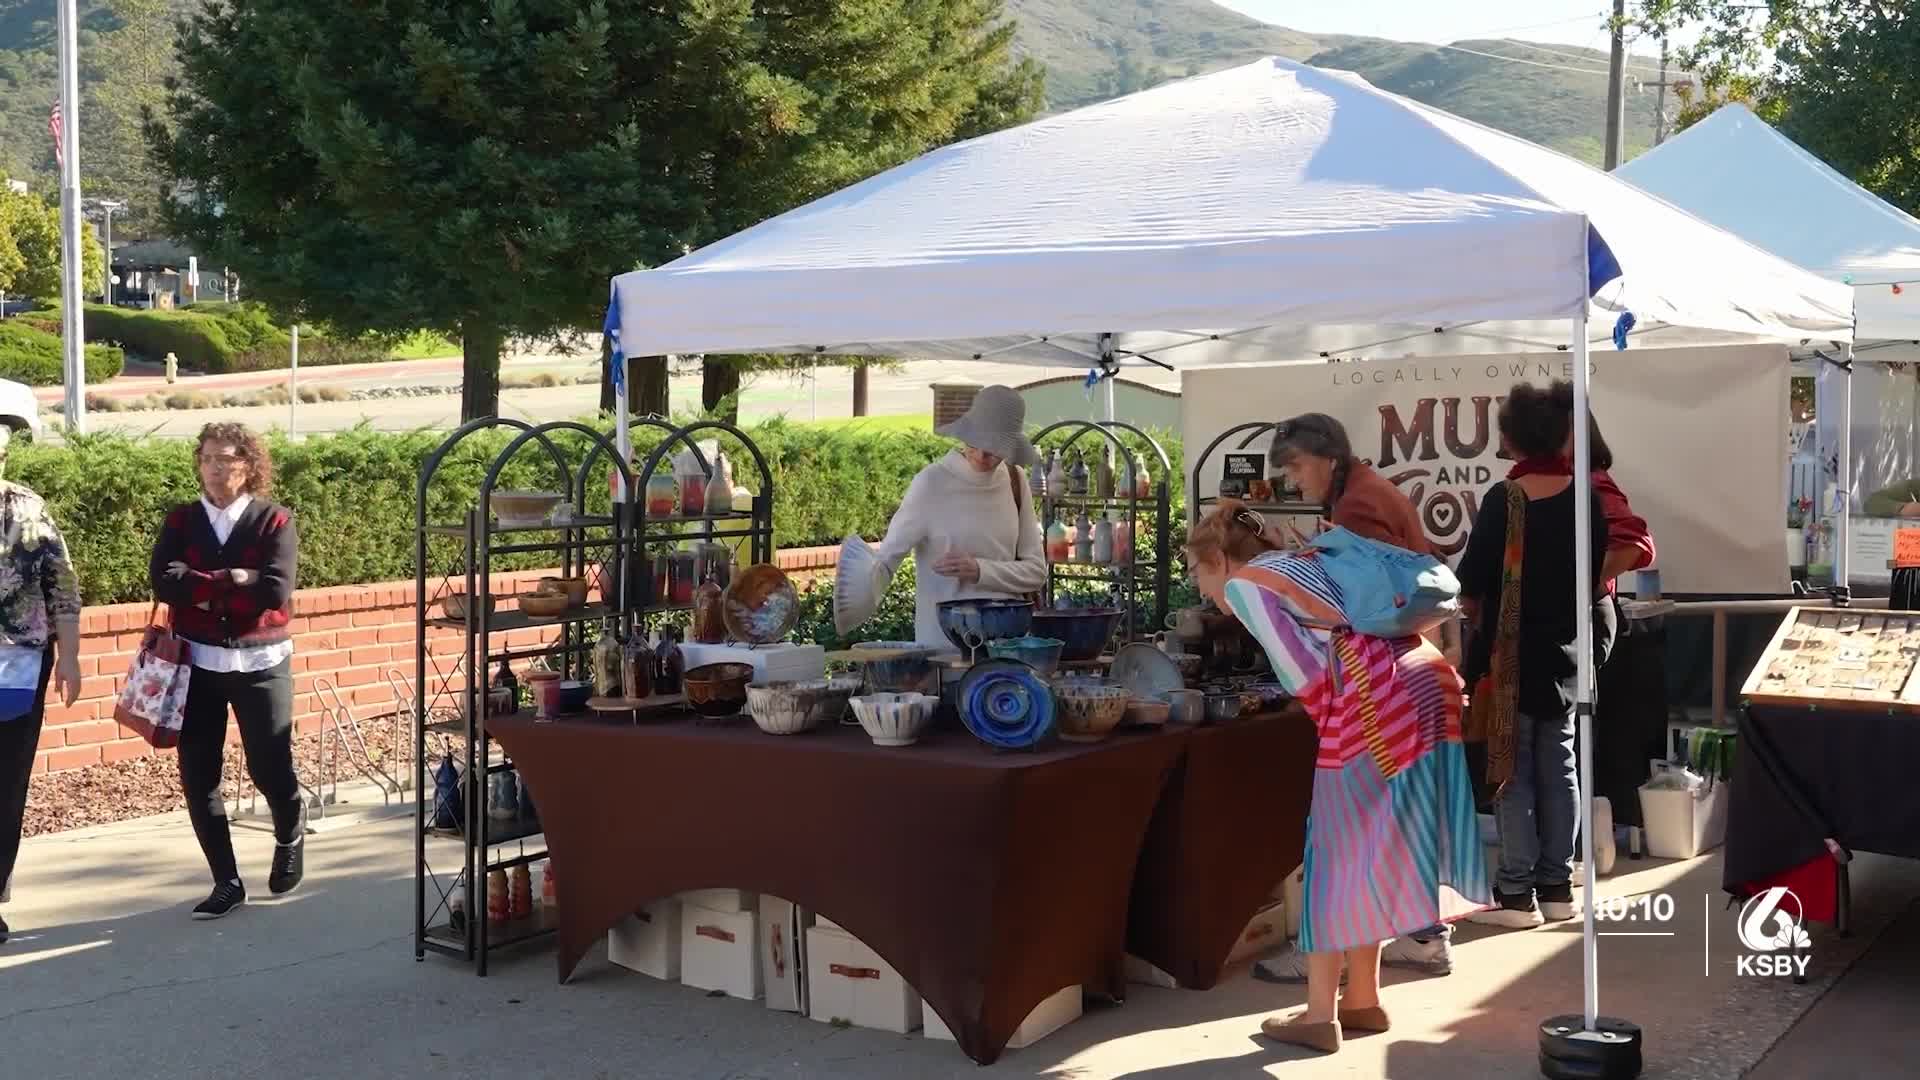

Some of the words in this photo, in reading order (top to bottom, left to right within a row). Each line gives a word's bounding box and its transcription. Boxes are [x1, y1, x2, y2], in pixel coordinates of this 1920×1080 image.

[1332, 366, 1462, 386] LOCALLY
[1377, 395, 1514, 468] MU
[1435, 465, 1491, 485] AND
